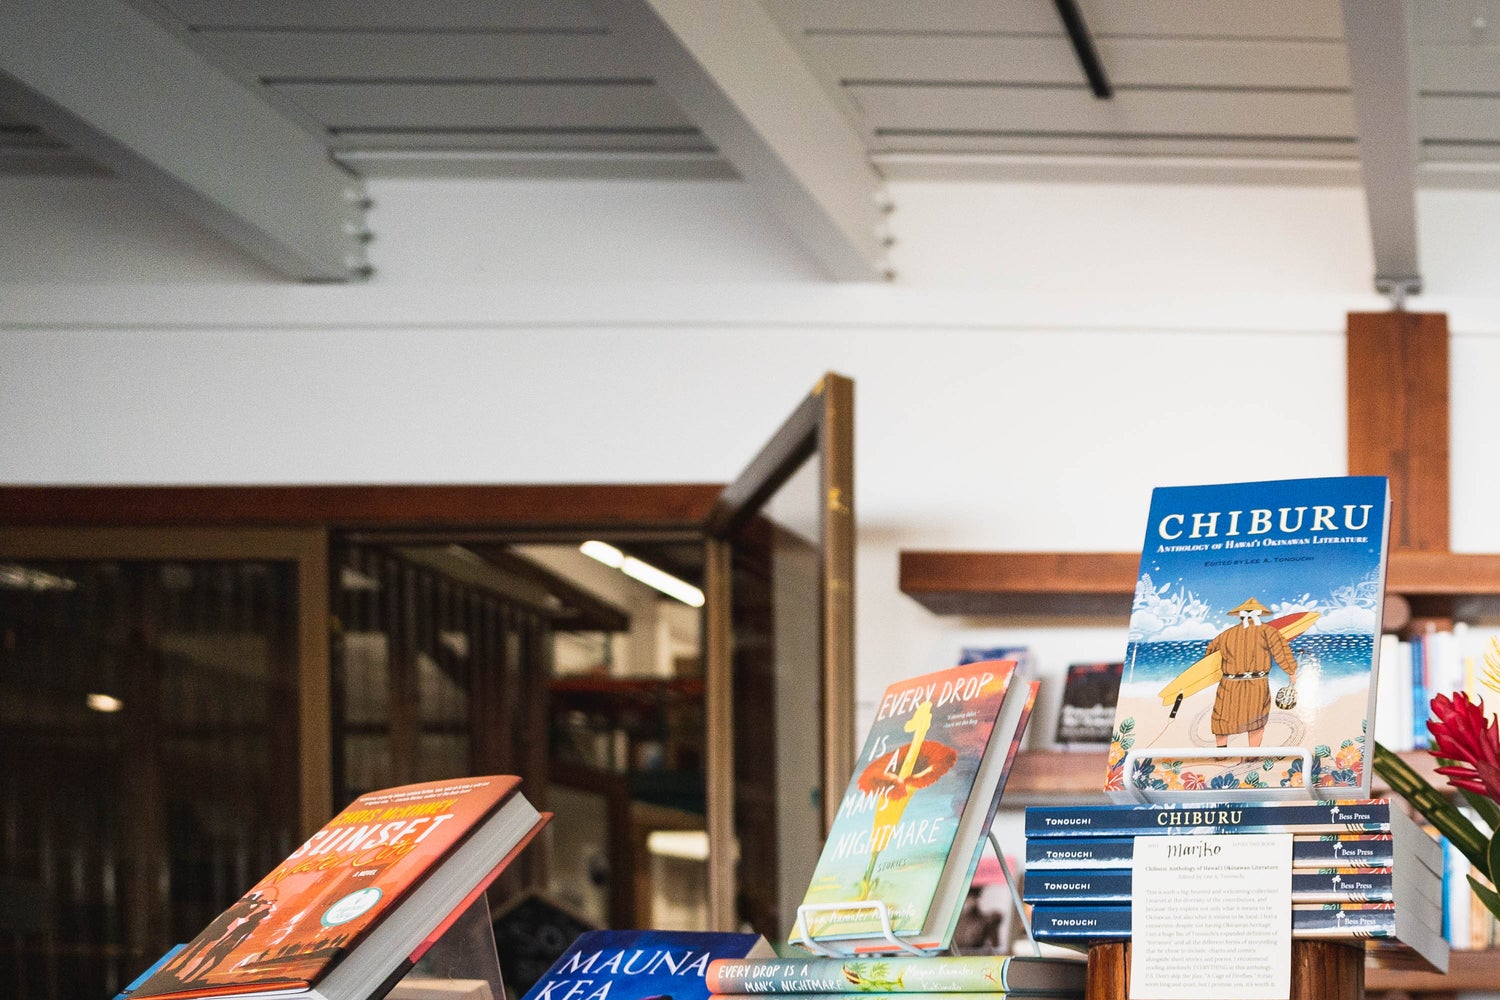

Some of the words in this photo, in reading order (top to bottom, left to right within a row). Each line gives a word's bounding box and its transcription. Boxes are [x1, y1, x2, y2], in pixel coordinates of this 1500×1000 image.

[1158, 504, 1374, 540] CHIBURU
[877, 683, 936, 721] EVERY
[937, 672, 993, 708] DROP
[869, 735, 887, 762] IS
[884, 749, 900, 775] A
[838, 785, 896, 819] MAN'S
[330, 808, 382, 827] CHRIS
[1045, 818, 1091, 826] TONOUCHI
[1157, 811, 1243, 826] CHIBURU
[287, 813, 454, 860] SUNSET
[831, 817, 944, 862] NIGHTMARE
[1342, 848, 1356, 856] Bess
[1357, 848, 1373, 856] Press
[1044, 882, 1090, 890] TONOUCHI
[1051, 918, 1097, 926] TONOUCHI
[556, 949, 711, 977] MAUNA
[718, 965, 750, 980] EVERY
[751, 964, 780, 979] DROP
[784, 964, 796, 977] IS
[800, 964, 809, 976] A
[744, 980, 776, 993] MAN'S
[781, 979, 843, 992] NIGHTMARE
